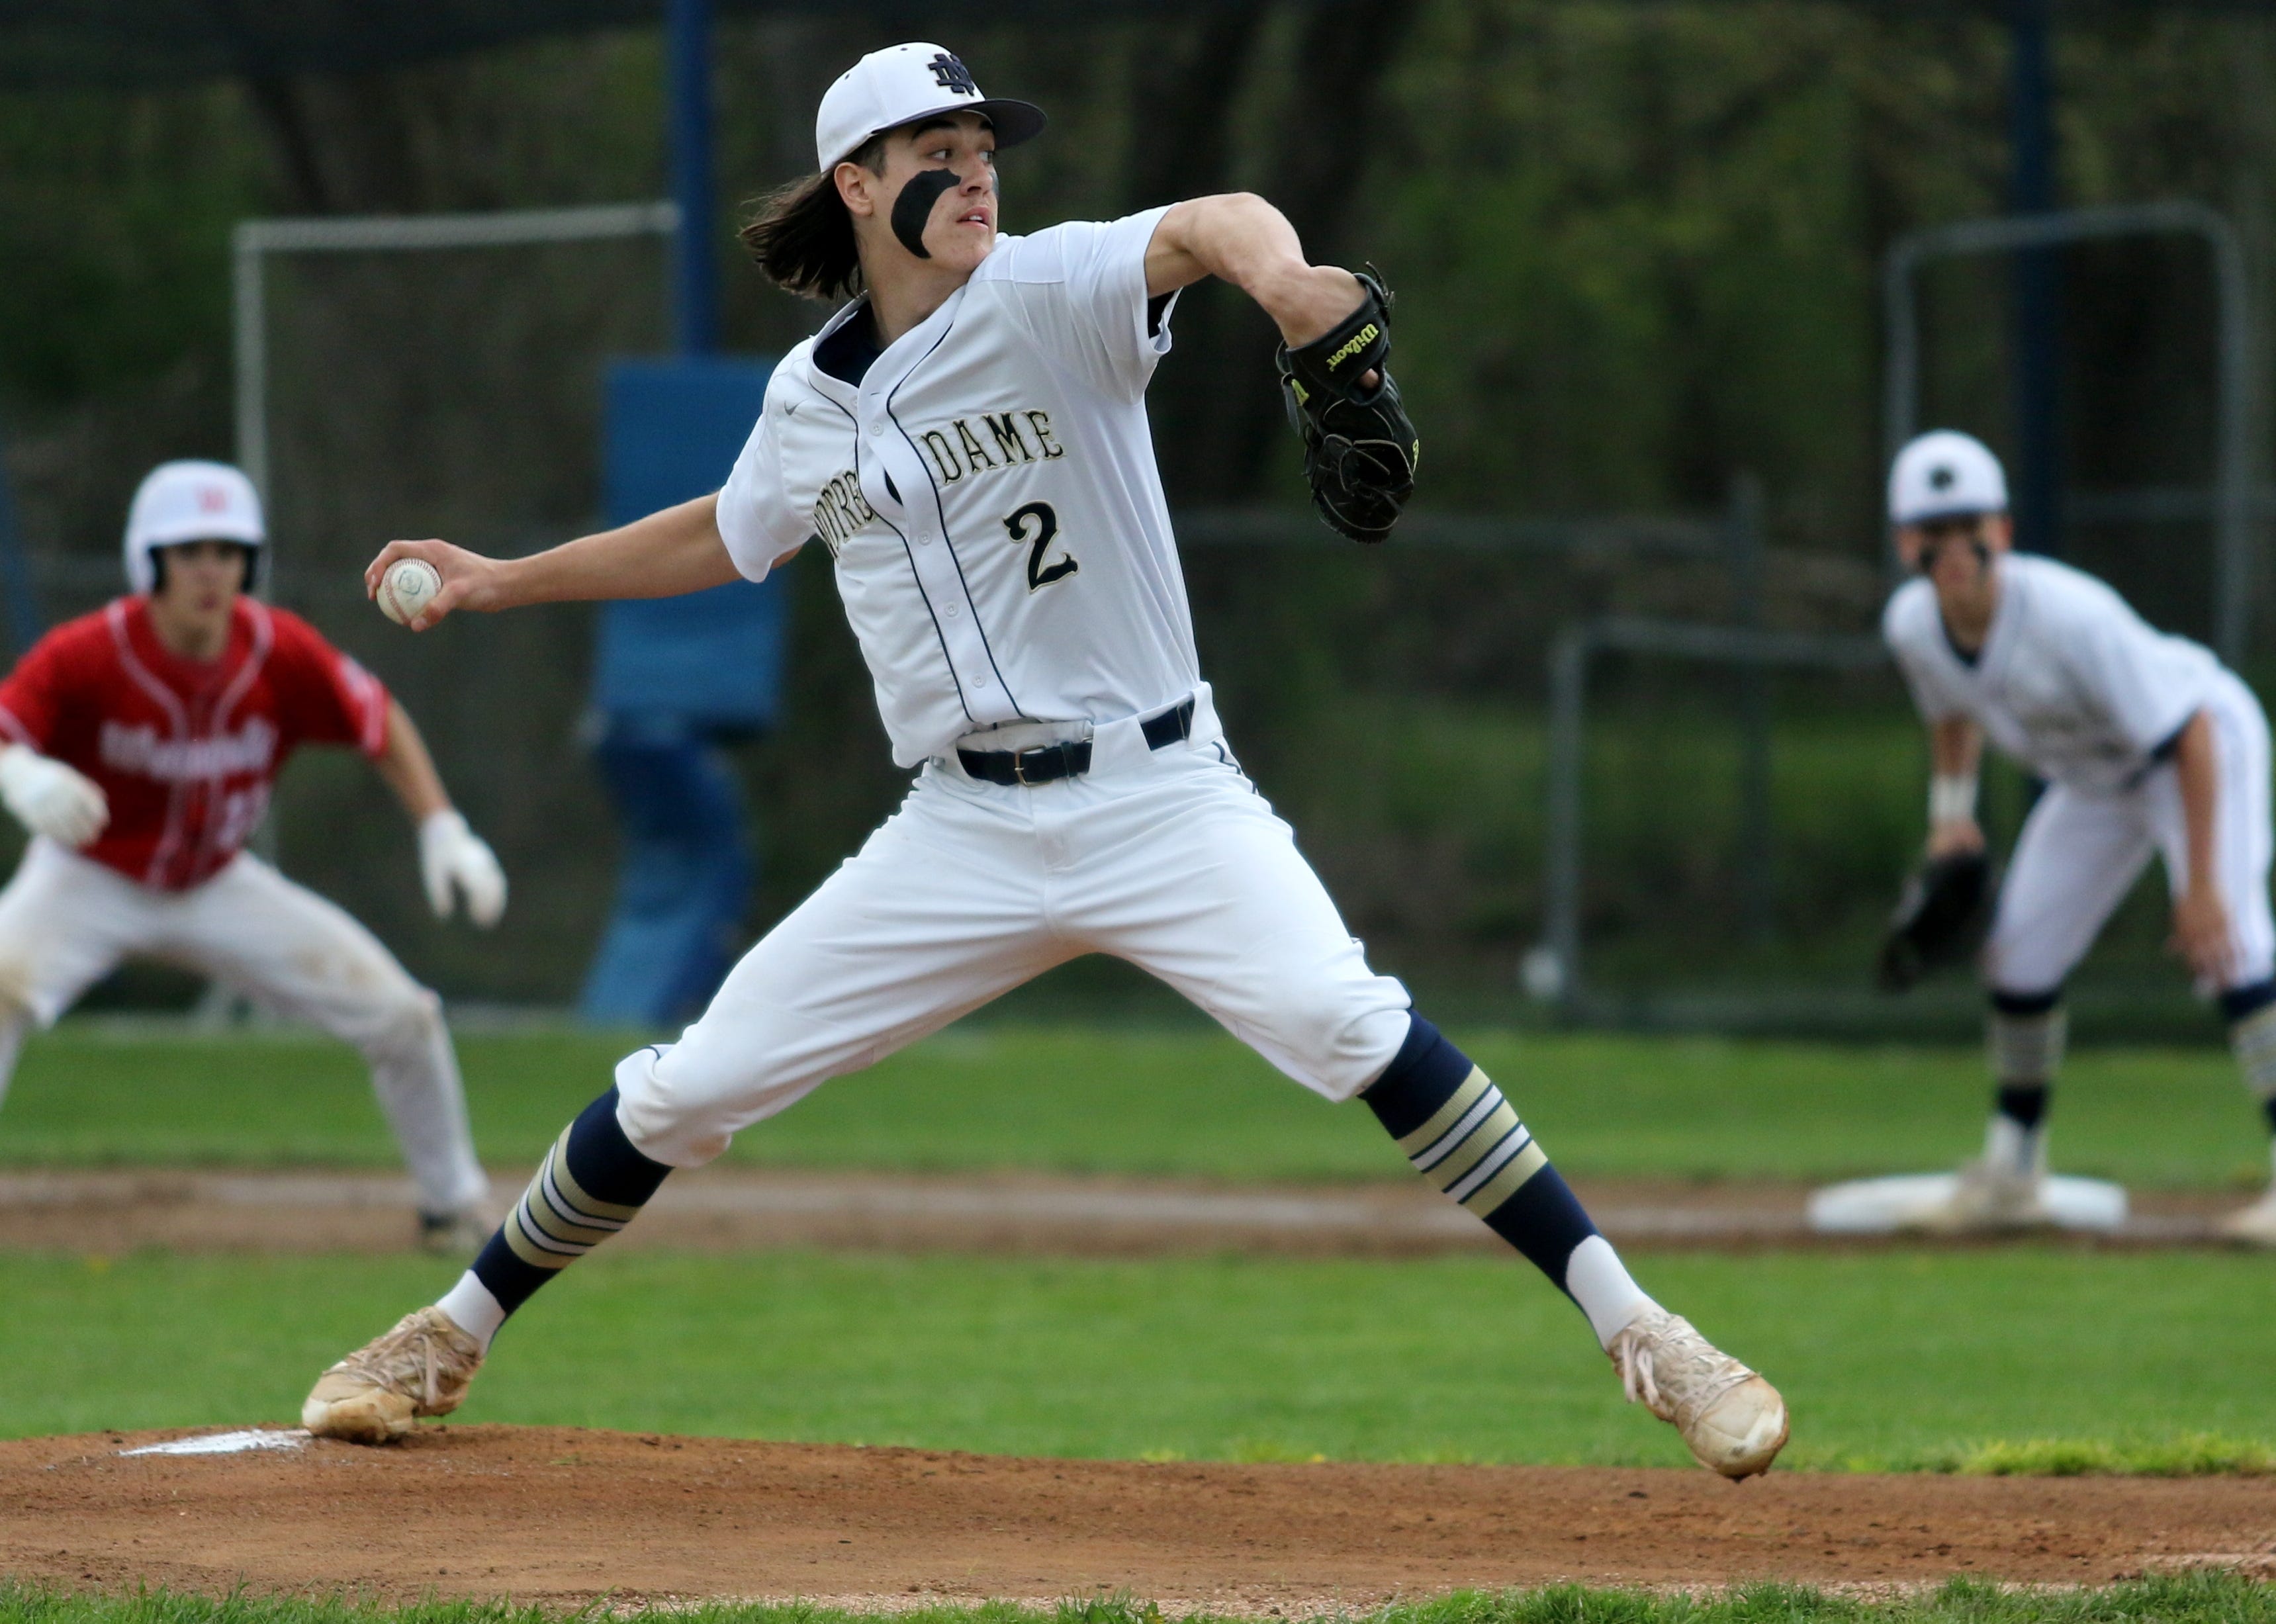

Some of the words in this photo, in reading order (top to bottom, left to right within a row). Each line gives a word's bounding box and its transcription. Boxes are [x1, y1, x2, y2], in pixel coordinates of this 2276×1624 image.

[1326, 323, 1379, 367] Wilson
[921, 410, 1065, 484] DAME
[1003, 500, 1079, 594] 2
